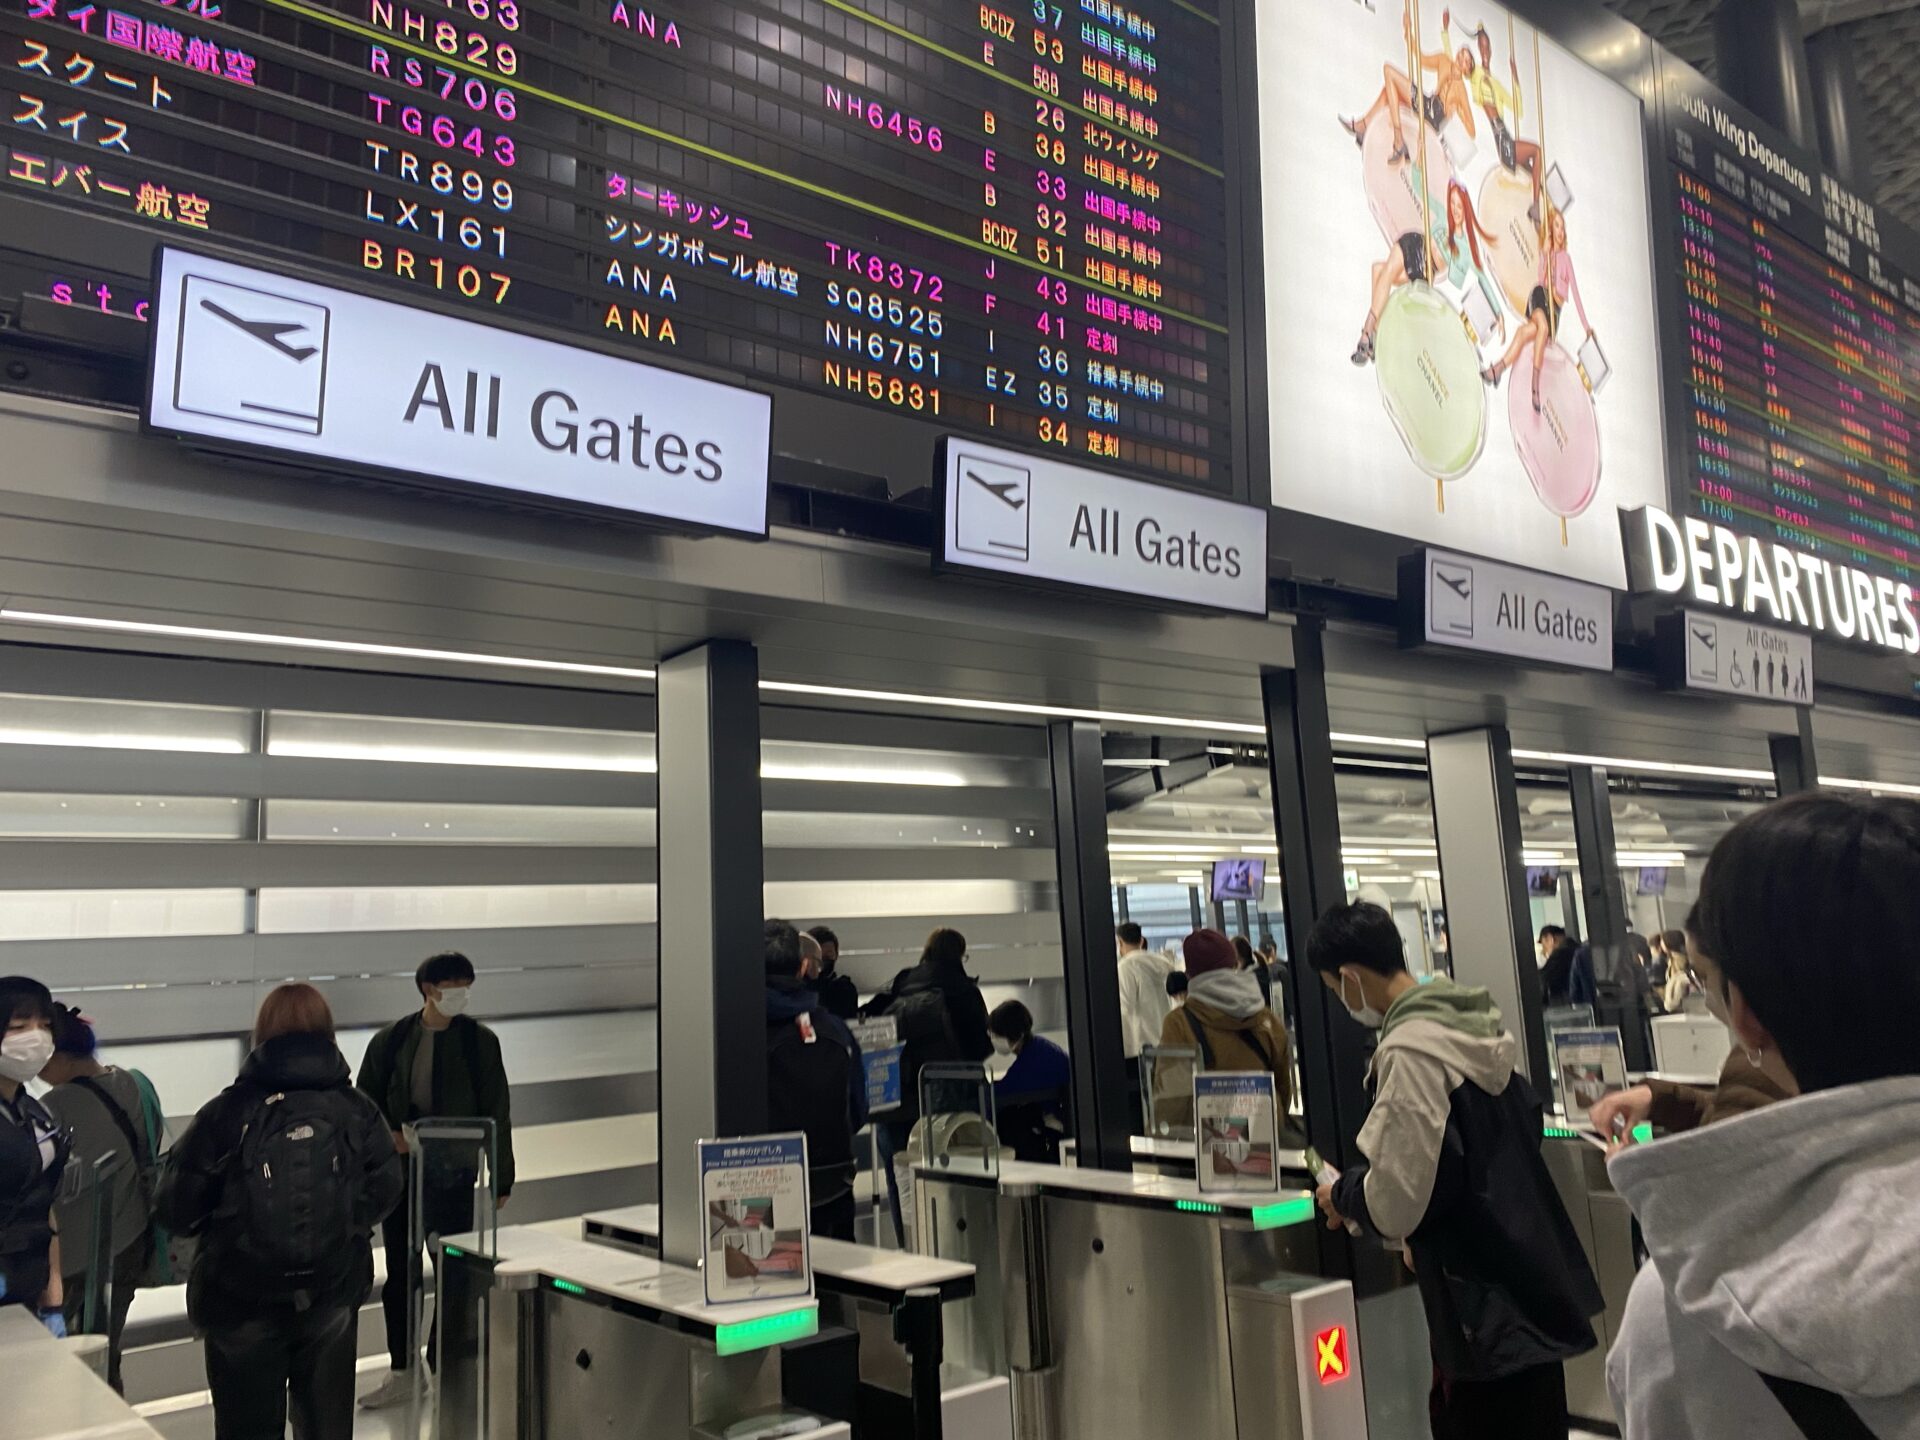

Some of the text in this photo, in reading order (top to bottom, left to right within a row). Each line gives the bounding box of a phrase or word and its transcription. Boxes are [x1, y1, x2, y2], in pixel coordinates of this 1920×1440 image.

[371, 0, 517, 76] NH829
[612, 2, 681, 49] ANA
[1034, 0, 1063, 31] 37
[983, 40, 994, 67] E
[1034, 28, 1064, 64] 53
[1081, 22, 1157, 75] 出国手続中
[18, 39, 172, 108] スクート
[371, 45, 517, 122] RS706
[1082, 54, 1158, 107] 出国手続中
[13, 94, 132, 153] スイス
[369, 92, 517, 167] TG643
[826, 84, 943, 152] NH6456
[984, 110, 996, 135] B
[1036, 99, 1065, 133] 26
[1083, 88, 1158, 140] 出国手続中
[1676, 91, 1710, 127] outh
[985, 147, 996, 172] E
[1036, 132, 1066, 166] 38
[9, 152, 210, 230] エバー航空
[366, 140, 513, 211] TR899
[985, 183, 996, 207] B
[1037, 169, 1067, 201] 33
[1084, 153, 1160, 203] 出国手続中
[366, 190, 507, 257] LX161
[608, 173, 752, 240] ターキッシュ
[1037, 203, 1067, 236] 32
[1085, 189, 1161, 237] 出国手続中
[605, 215, 799, 297] シンガポール航空
[985, 259, 995, 279] J
[1037, 237, 1063, 269] 51
[1085, 223, 1161, 270] 出国手続中
[364, 240, 511, 304] BR107
[606, 258, 677, 302] ANA
[826, 241, 943, 302] TK8372
[1037, 276, 1067, 305] 43
[1086, 257, 1162, 302] 出国手続中
[605, 304, 676, 345] ANA
[827, 281, 943, 337] SQ8525
[986, 294, 996, 315] F
[1037, 311, 1065, 340] 41
[1086, 292, 1162, 336] 出国手続中
[825, 320, 940, 377] NH6751
[1038, 345, 1069, 376] 36
[1086, 327, 1118, 356] 定刻
[825, 361, 940, 415] NH5831
[1038, 380, 1068, 411] 35
[1086, 358, 1164, 402] 搭乗手続中
[403, 361, 724, 483] All Gates
[1038, 416, 1068, 446] 34
[1087, 395, 1119, 423] 定刻
[1087, 429, 1119, 459] 定刻
[1069, 503, 1242, 579] All Gates
[1645, 505, 1920, 655] DEPARTURES
[1496, 590, 1598, 645] All Gates
[1746, 626, 1789, 655] All Gates
